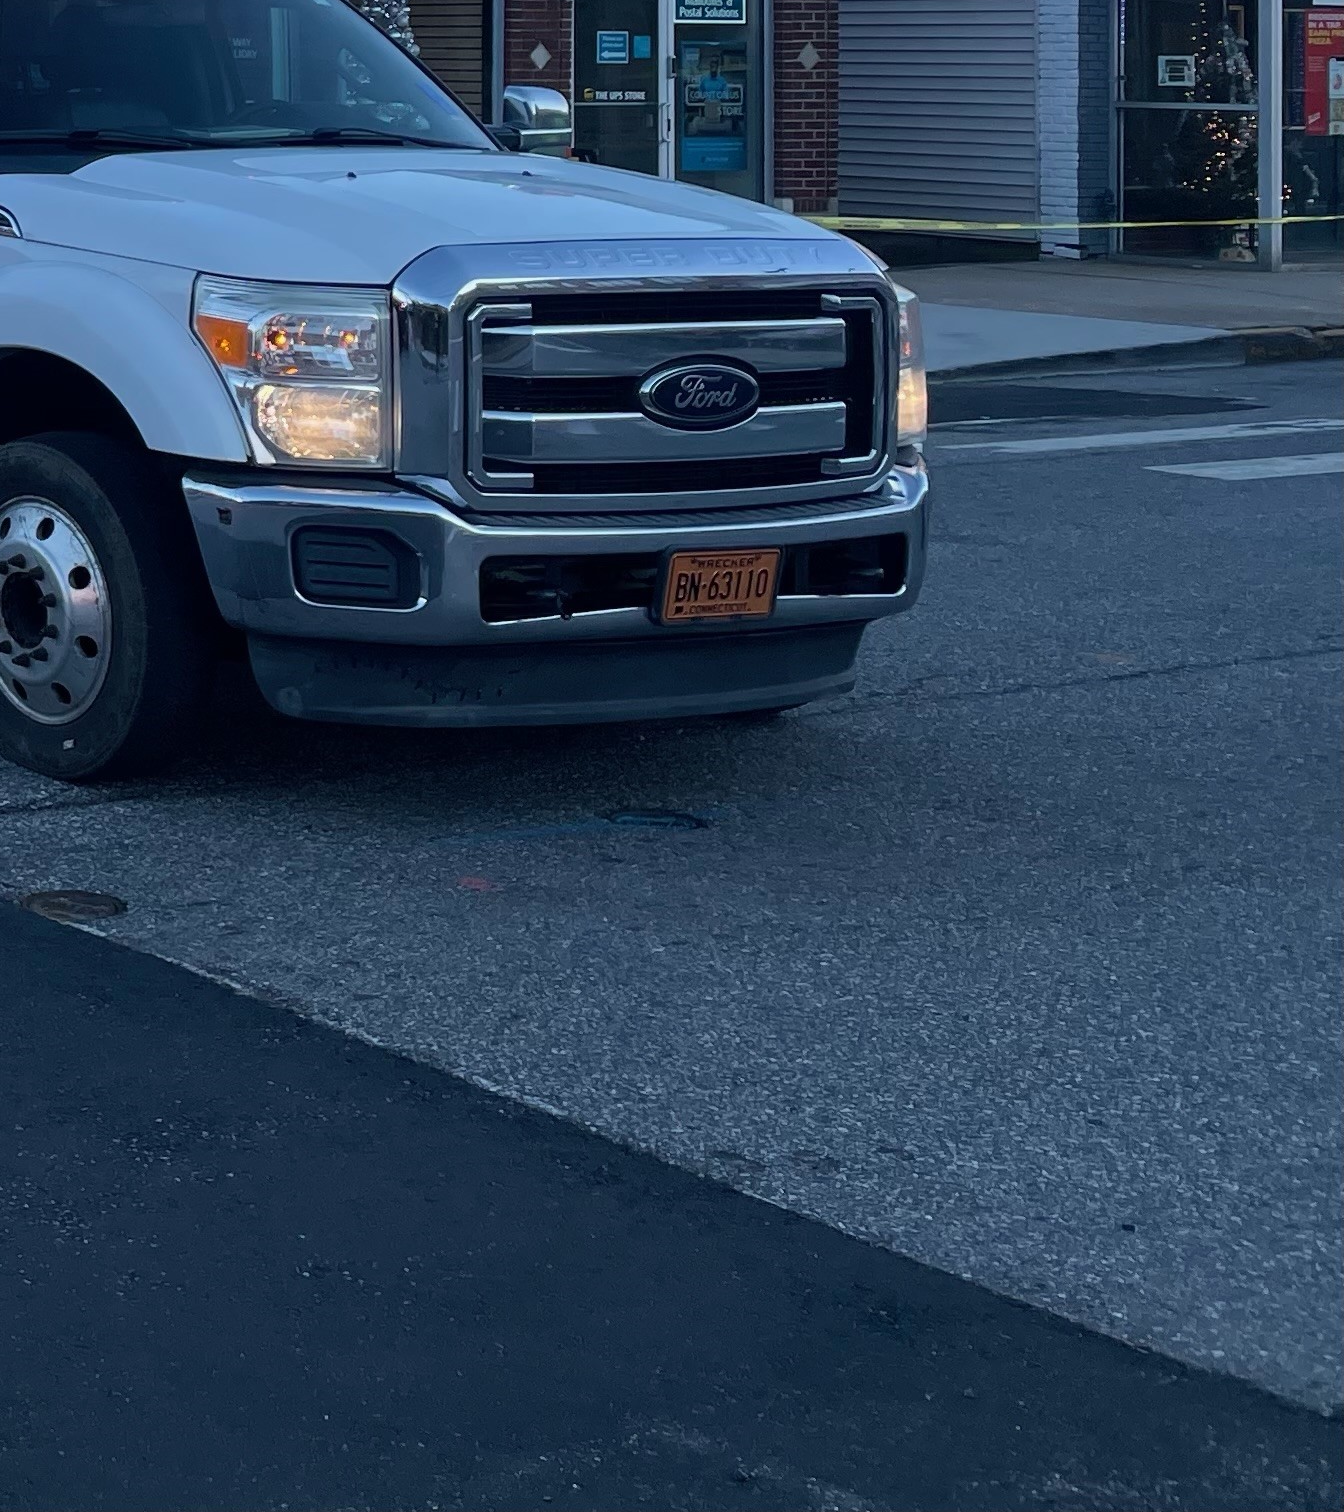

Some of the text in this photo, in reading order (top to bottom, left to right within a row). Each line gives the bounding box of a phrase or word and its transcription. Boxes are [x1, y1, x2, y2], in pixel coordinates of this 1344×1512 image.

[679, 6, 740, 17] Postal Solutions
[674, 373, 738, 409] Ford
[697, 557, 754, 568] WRECKER
